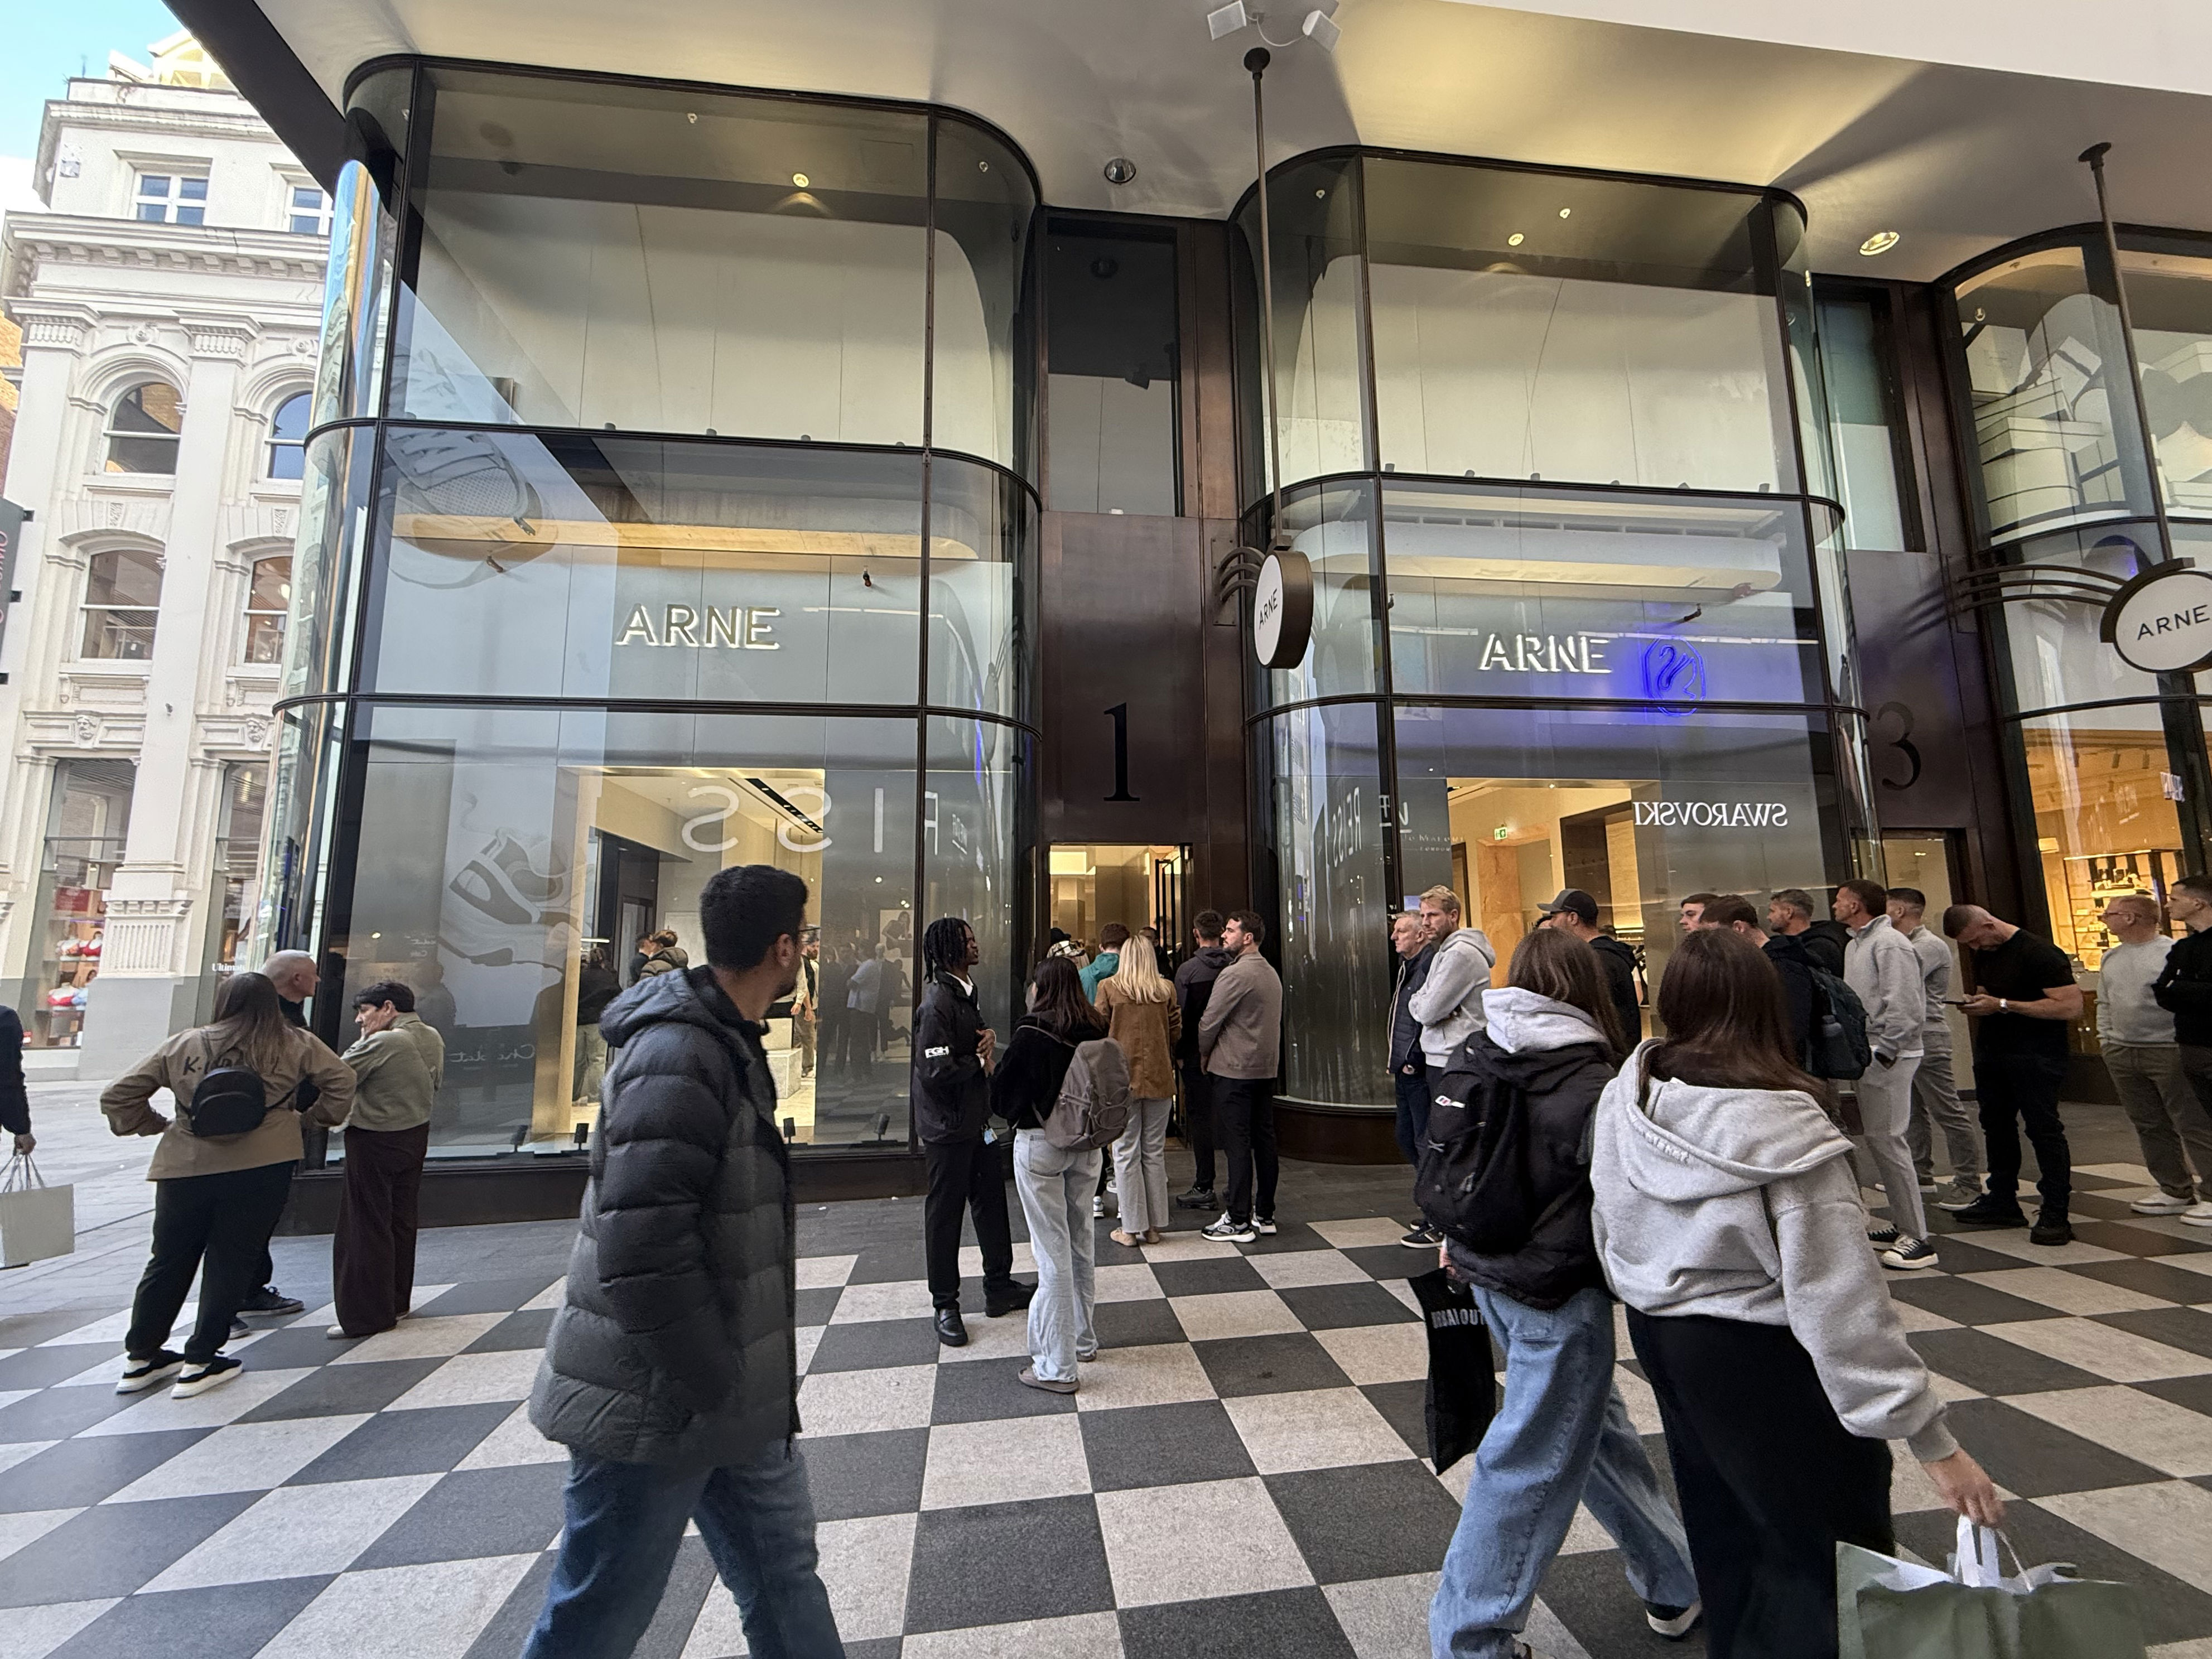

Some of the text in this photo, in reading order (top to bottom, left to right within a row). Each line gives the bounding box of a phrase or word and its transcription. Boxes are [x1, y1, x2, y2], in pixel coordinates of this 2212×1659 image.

[615, 603, 782, 650] ARNE
[1258, 589, 1278, 630] ARNE
[2136, 604, 2210, 641] ARNE
[1478, 633, 1613, 674] ARNE
[1103, 702, 1140, 802] 1
[1877, 701, 1922, 790] 3
